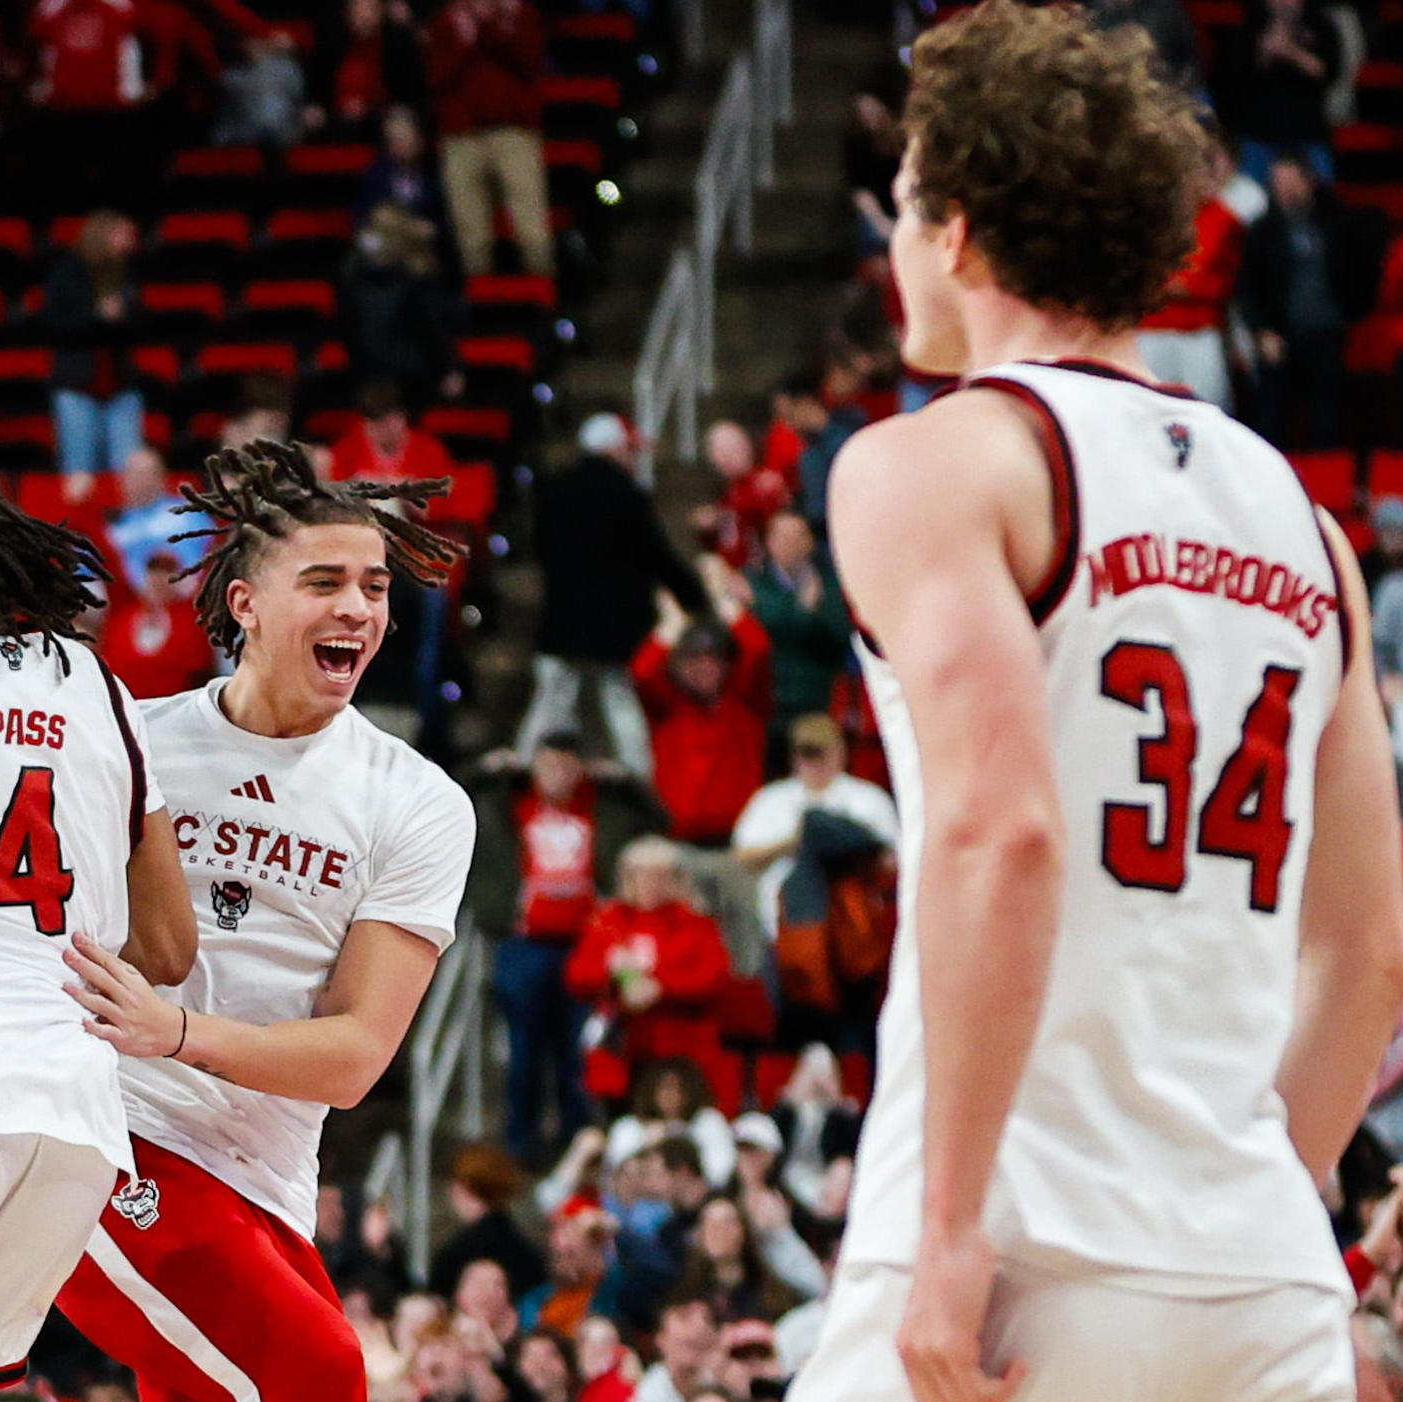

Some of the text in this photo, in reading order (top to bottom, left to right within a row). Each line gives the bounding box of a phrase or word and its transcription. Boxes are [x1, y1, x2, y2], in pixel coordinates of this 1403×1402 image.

[1100, 639, 1303, 913] 34
[173, 815, 348, 889] C STATE
[188, 854, 319, 897] SKETBALL
